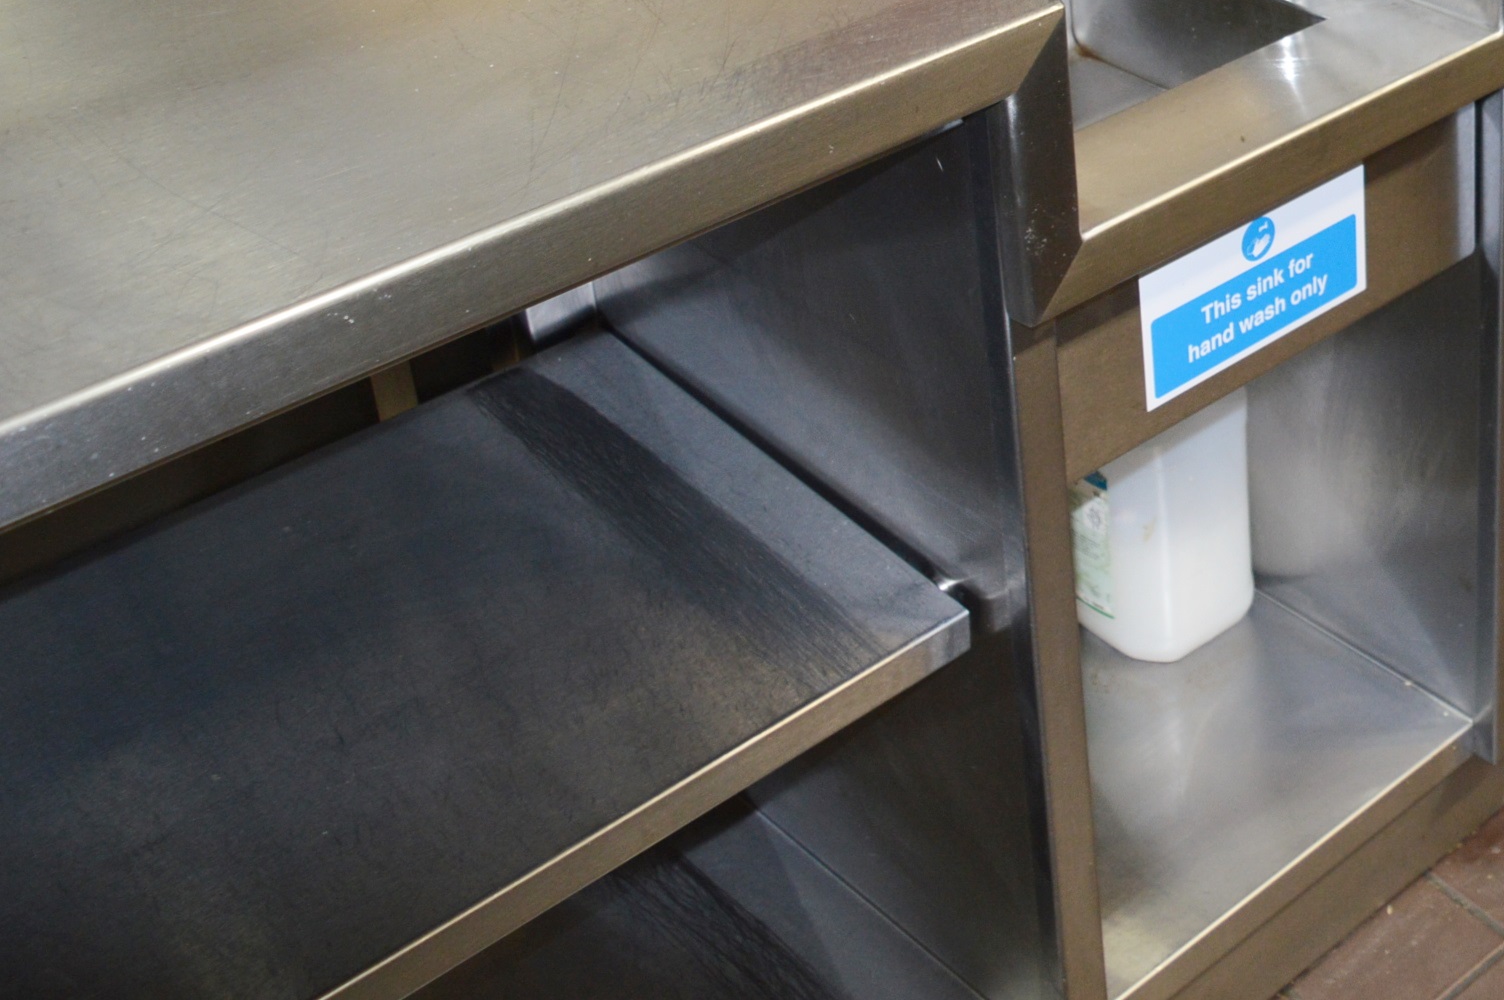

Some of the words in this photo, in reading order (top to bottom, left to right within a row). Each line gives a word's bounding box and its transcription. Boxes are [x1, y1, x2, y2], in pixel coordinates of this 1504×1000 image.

[1188, 324, 1235, 363] hand
[1239, 297, 1286, 334] wash
[1290, 274, 1328, 305] only
[1201, 292, 1242, 324] This
[1246, 268, 1285, 300] sink
[1289, 254, 1313, 278] for
